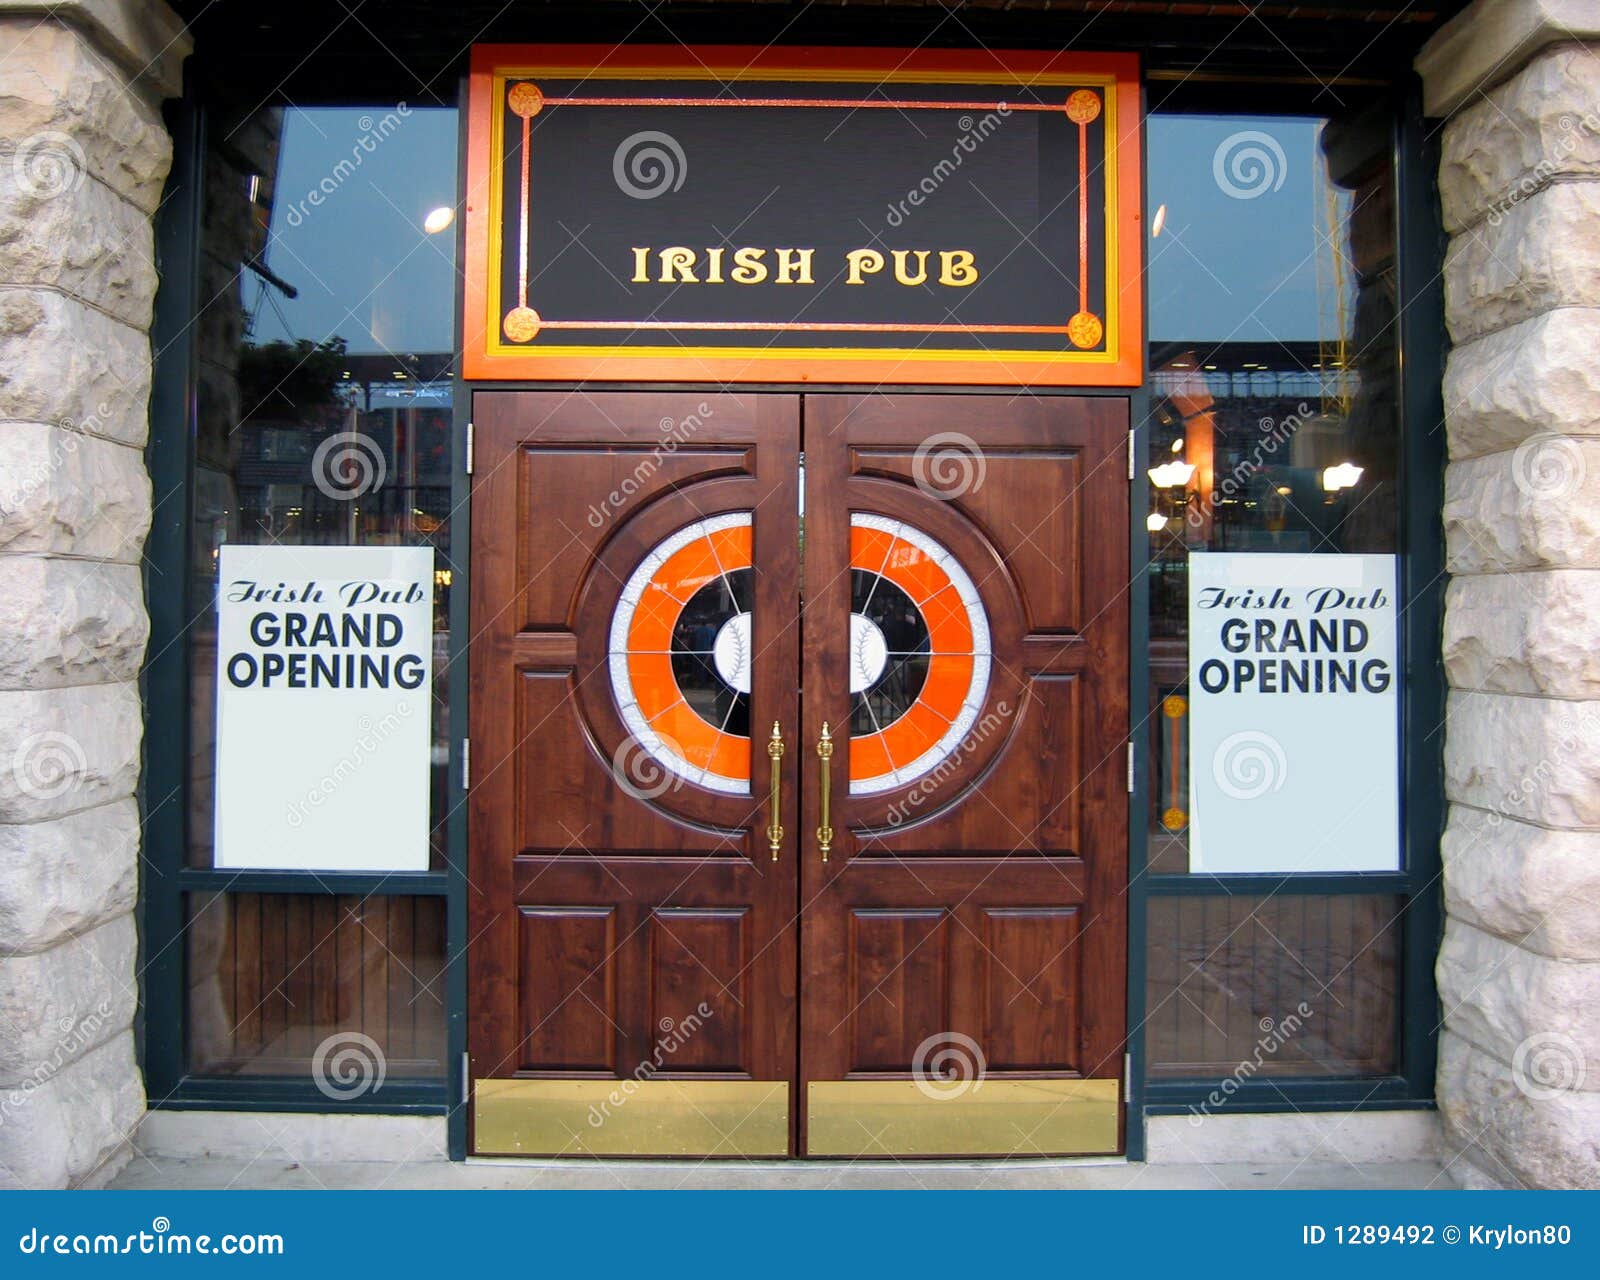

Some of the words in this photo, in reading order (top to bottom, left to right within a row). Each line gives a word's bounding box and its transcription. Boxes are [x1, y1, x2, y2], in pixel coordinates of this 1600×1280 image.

[631, 247, 815, 285] IRISH
[846, 248, 980, 287] PUB
[227, 580, 327, 604] Irish
[339, 581, 425, 608] Pub
[1197, 587, 1294, 609] Irish
[1306, 587, 1391, 614] Pub
[250, 611, 404, 648] GRAND
[1221, 618, 1369, 654] GRAND
[227, 652, 426, 690] OPENING
[1199, 658, 1391, 694] OPENING
